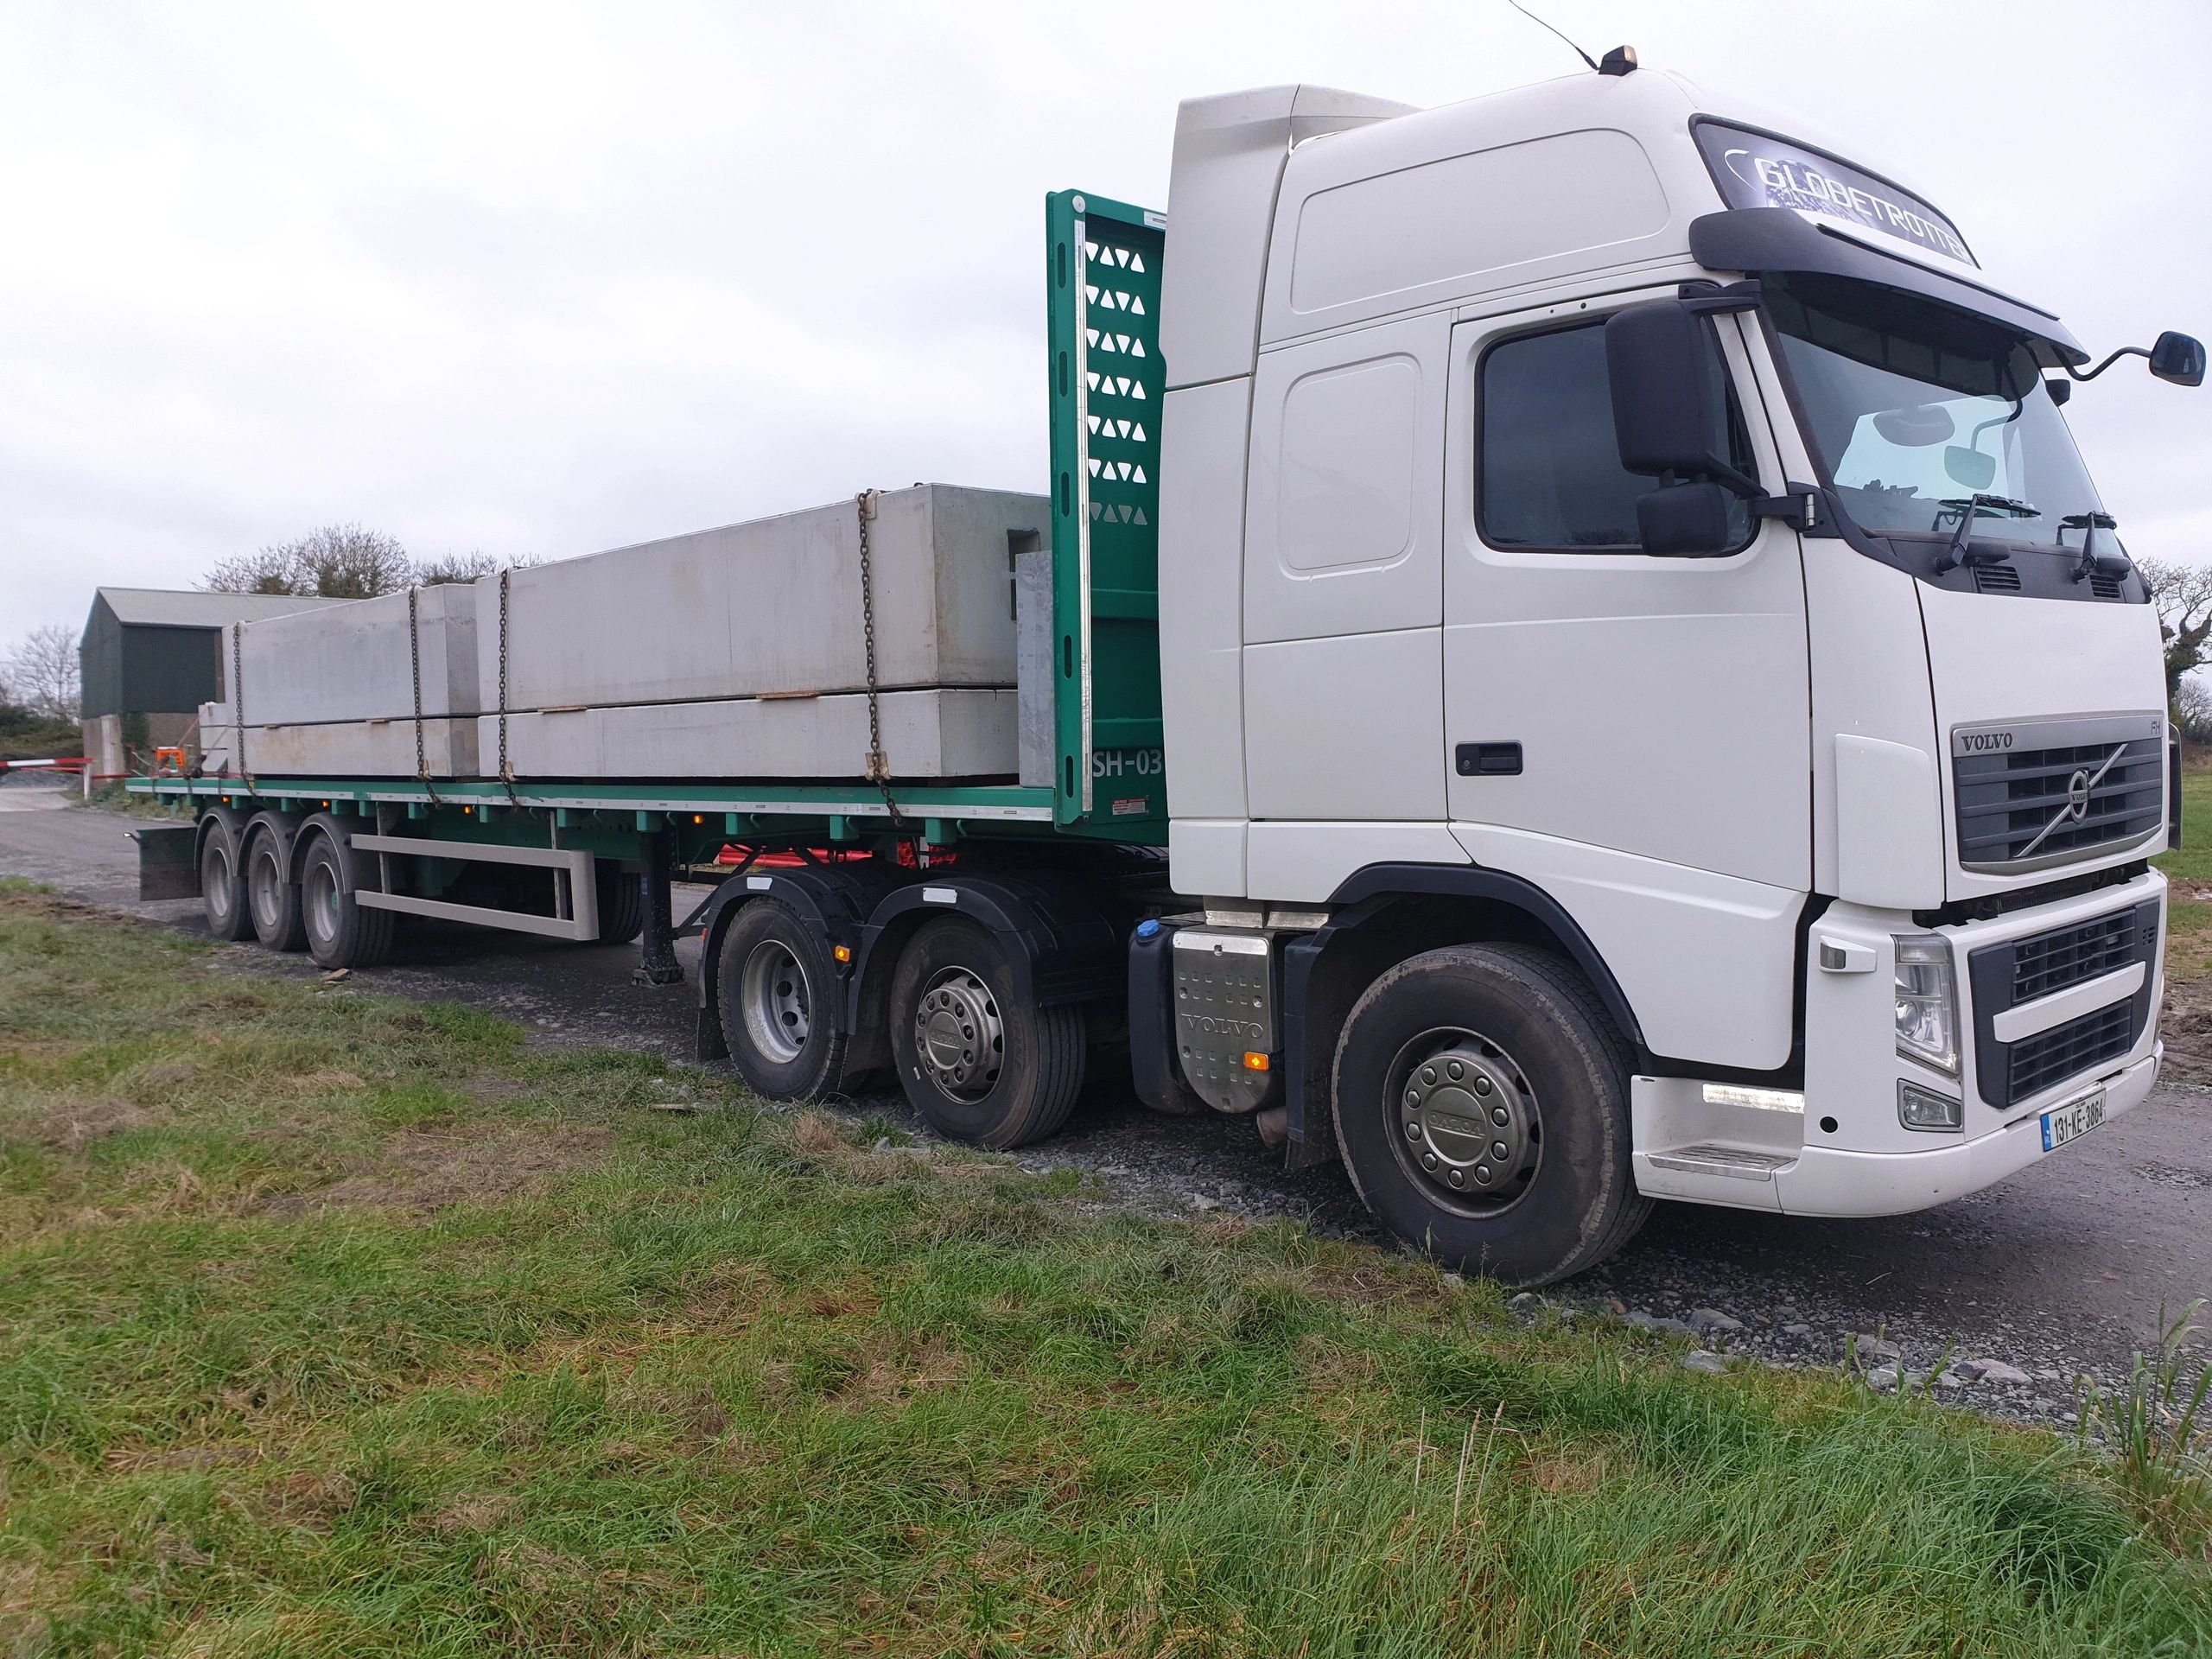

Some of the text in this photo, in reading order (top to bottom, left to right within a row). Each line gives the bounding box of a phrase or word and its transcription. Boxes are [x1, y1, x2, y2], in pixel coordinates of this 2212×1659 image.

[1753, 156, 1973, 265] GLOBETROTTER
[1961, 733, 2013, 751] VOLVO
[1092, 749, 1162, 778] SH-03
[1180, 1013, 1264, 1039] VOLVO
